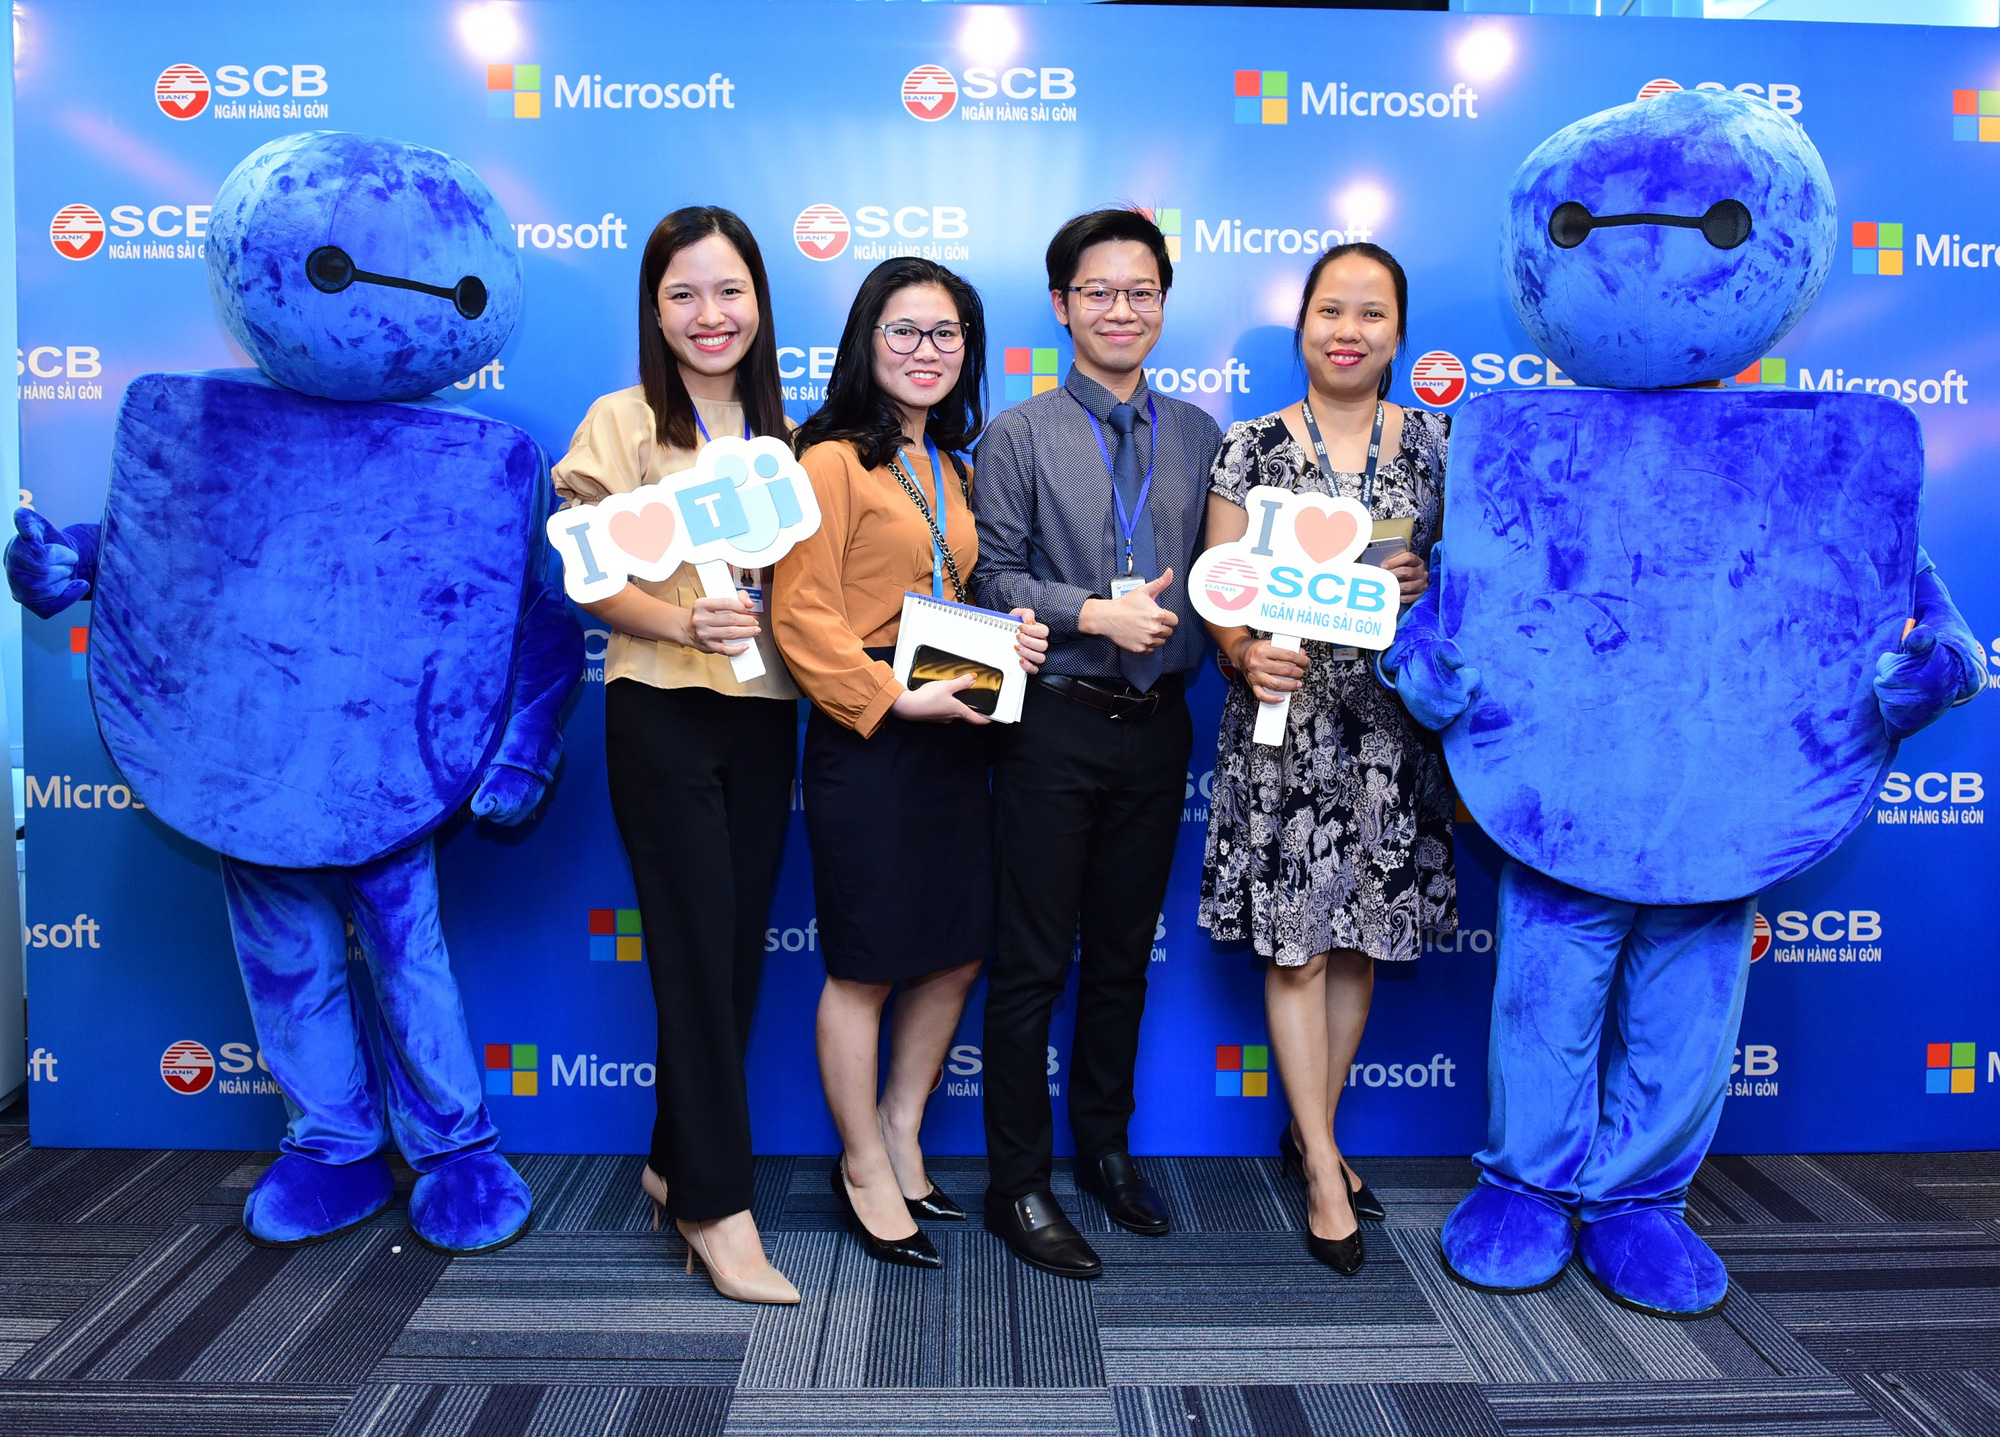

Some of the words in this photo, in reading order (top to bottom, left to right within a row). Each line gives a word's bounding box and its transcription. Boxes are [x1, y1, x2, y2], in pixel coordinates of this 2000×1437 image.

[214, 64, 329, 97] SCB
[554, 72, 735, 109] Microsoft
[961, 66, 1077, 100] SCB
[214, 100, 246, 119] NGÂN
[249, 100, 280, 119] HÀNG
[282, 100, 301, 119] SÀI
[304, 100, 328, 119] GÒN
[961, 102, 994, 121] NGÂN
[996, 102, 1028, 121] HÀNG
[1031, 102, 1049, 121] SÀI
[1052, 102, 1077, 121] GÒN
[1301, 81, 1478, 119] Microsoft
[510, 212, 628, 249] rosoft
[854, 206, 969, 239] SCB
[109, 240, 140, 259] NGÂN
[143, 240, 175, 259] HÀNG
[177, 240, 194, 259] SÀI
[854, 241, 886, 260] NGÂN
[923, 242, 942, 260] SÀI
[944, 242, 969, 260] GÒN
[1916, 233, 2000, 268] Micr
[24, 380, 55, 399] HÀNG
[57, 380, 75, 399] SÀI
[78, 380, 102, 399] GÒN
[799, 381, 818, 401] SÀI
[1143, 357, 1250, 393] rosoft
[1251, 500, 1283, 557] I
[565, 522, 608, 585] I
[1266, 566, 1386, 612] SCB
[1260, 601, 1295, 621] NGÂN
[1296, 606, 1331, 627] HÀNG
[1332, 612, 1353, 632] SÀI
[1355, 616, 1382, 637] GÒN
[1879, 772, 1985, 803] SCB
[1877, 806, 1907, 824] NGÂN
[1910, 806, 1939, 824] HÀNG
[1941, 806, 1959, 824] SÀI
[1961, 806, 1984, 824] GÒN
[1775, 910, 1882, 942] SCB
[1774, 943, 1804, 962] NGÂN
[1807, 943, 1837, 962] HÀNG
[1839, 943, 1857, 962] SÀI
[1858, 943, 1882, 962] GÒN
[218, 1076, 250, 1094] NGÂN
[1343, 1053, 1456, 1088] rosoft
[947, 1078, 979, 1097] NGÂN
[1735, 1078, 1753, 1097] SÀI
[1755, 1078, 1778, 1097] GÒN
